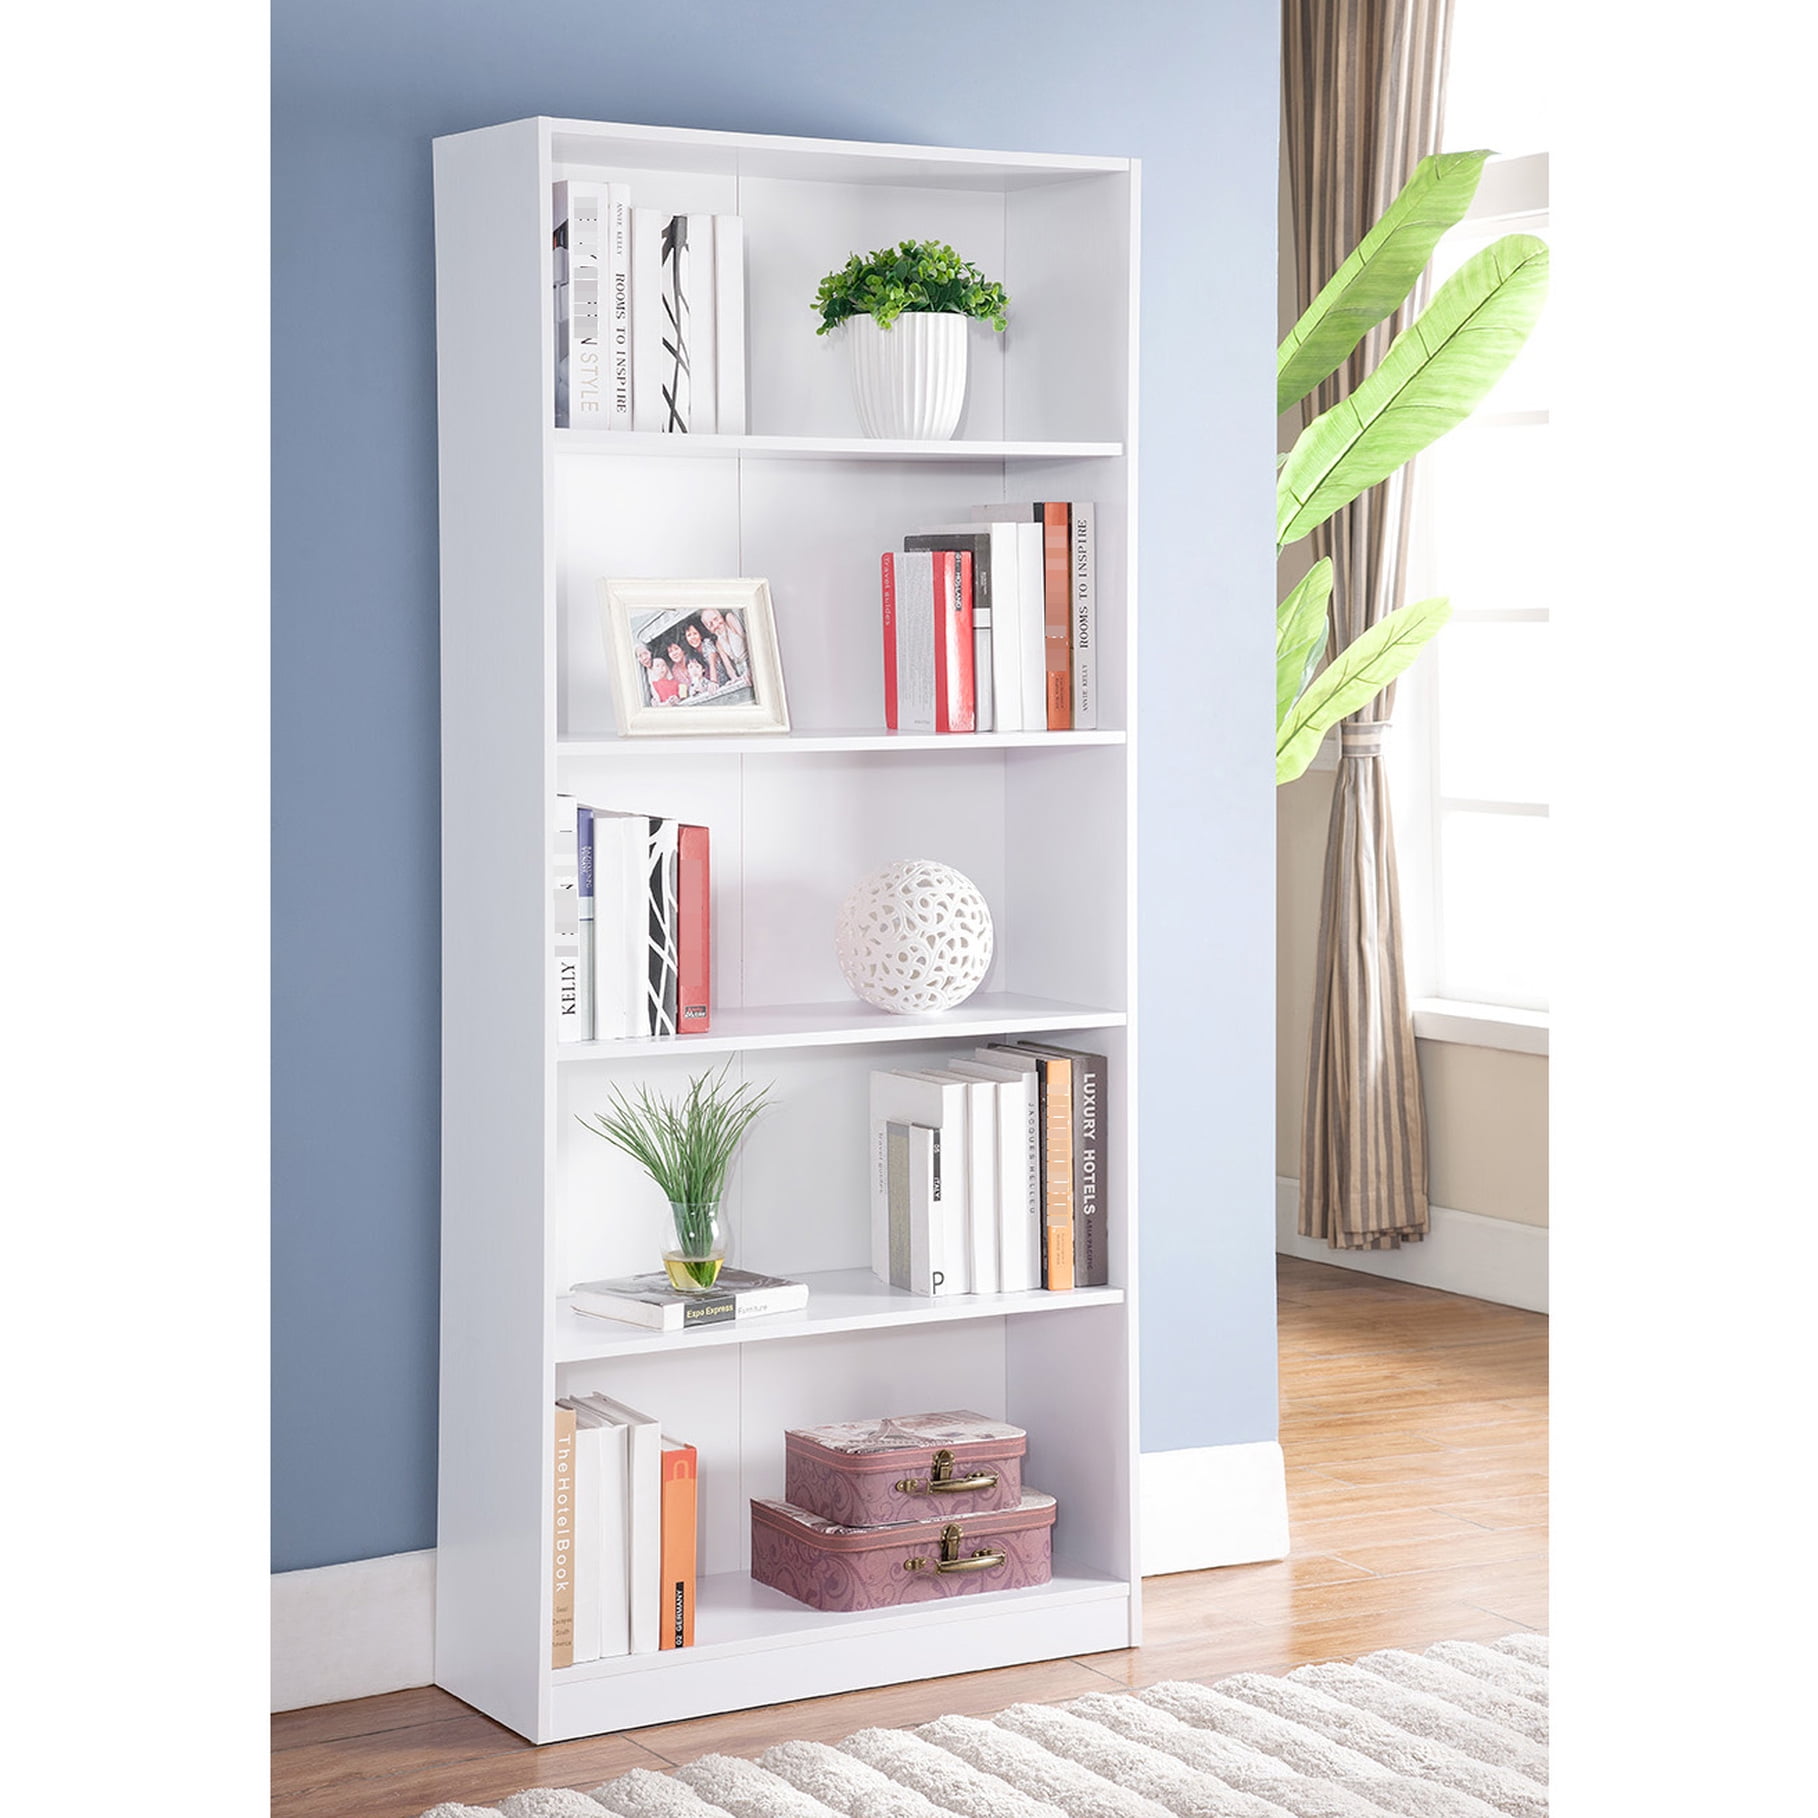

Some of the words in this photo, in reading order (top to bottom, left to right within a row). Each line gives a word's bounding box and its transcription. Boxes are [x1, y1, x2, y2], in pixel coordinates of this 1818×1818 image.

[615, 273, 625, 320] ROOMS
[616, 327, 626, 345] TO
[580, 352, 599, 412] STYLE
[616, 351, 627, 413] INSPIRE
[1077, 519, 1088, 577] INSPIRE
[1078, 583, 1088, 600] TO
[1079, 606, 1089, 649] ROOMS
[561, 962, 576, 1015] KELLY
[1083, 1073, 1096, 1140] LUXURY
[1083, 1150, 1096, 1215] HOTELS
[932, 1271, 945, 1295] P
[705, 1303, 734, 1315] Express
[676, 1635, 683, 1646] 02
